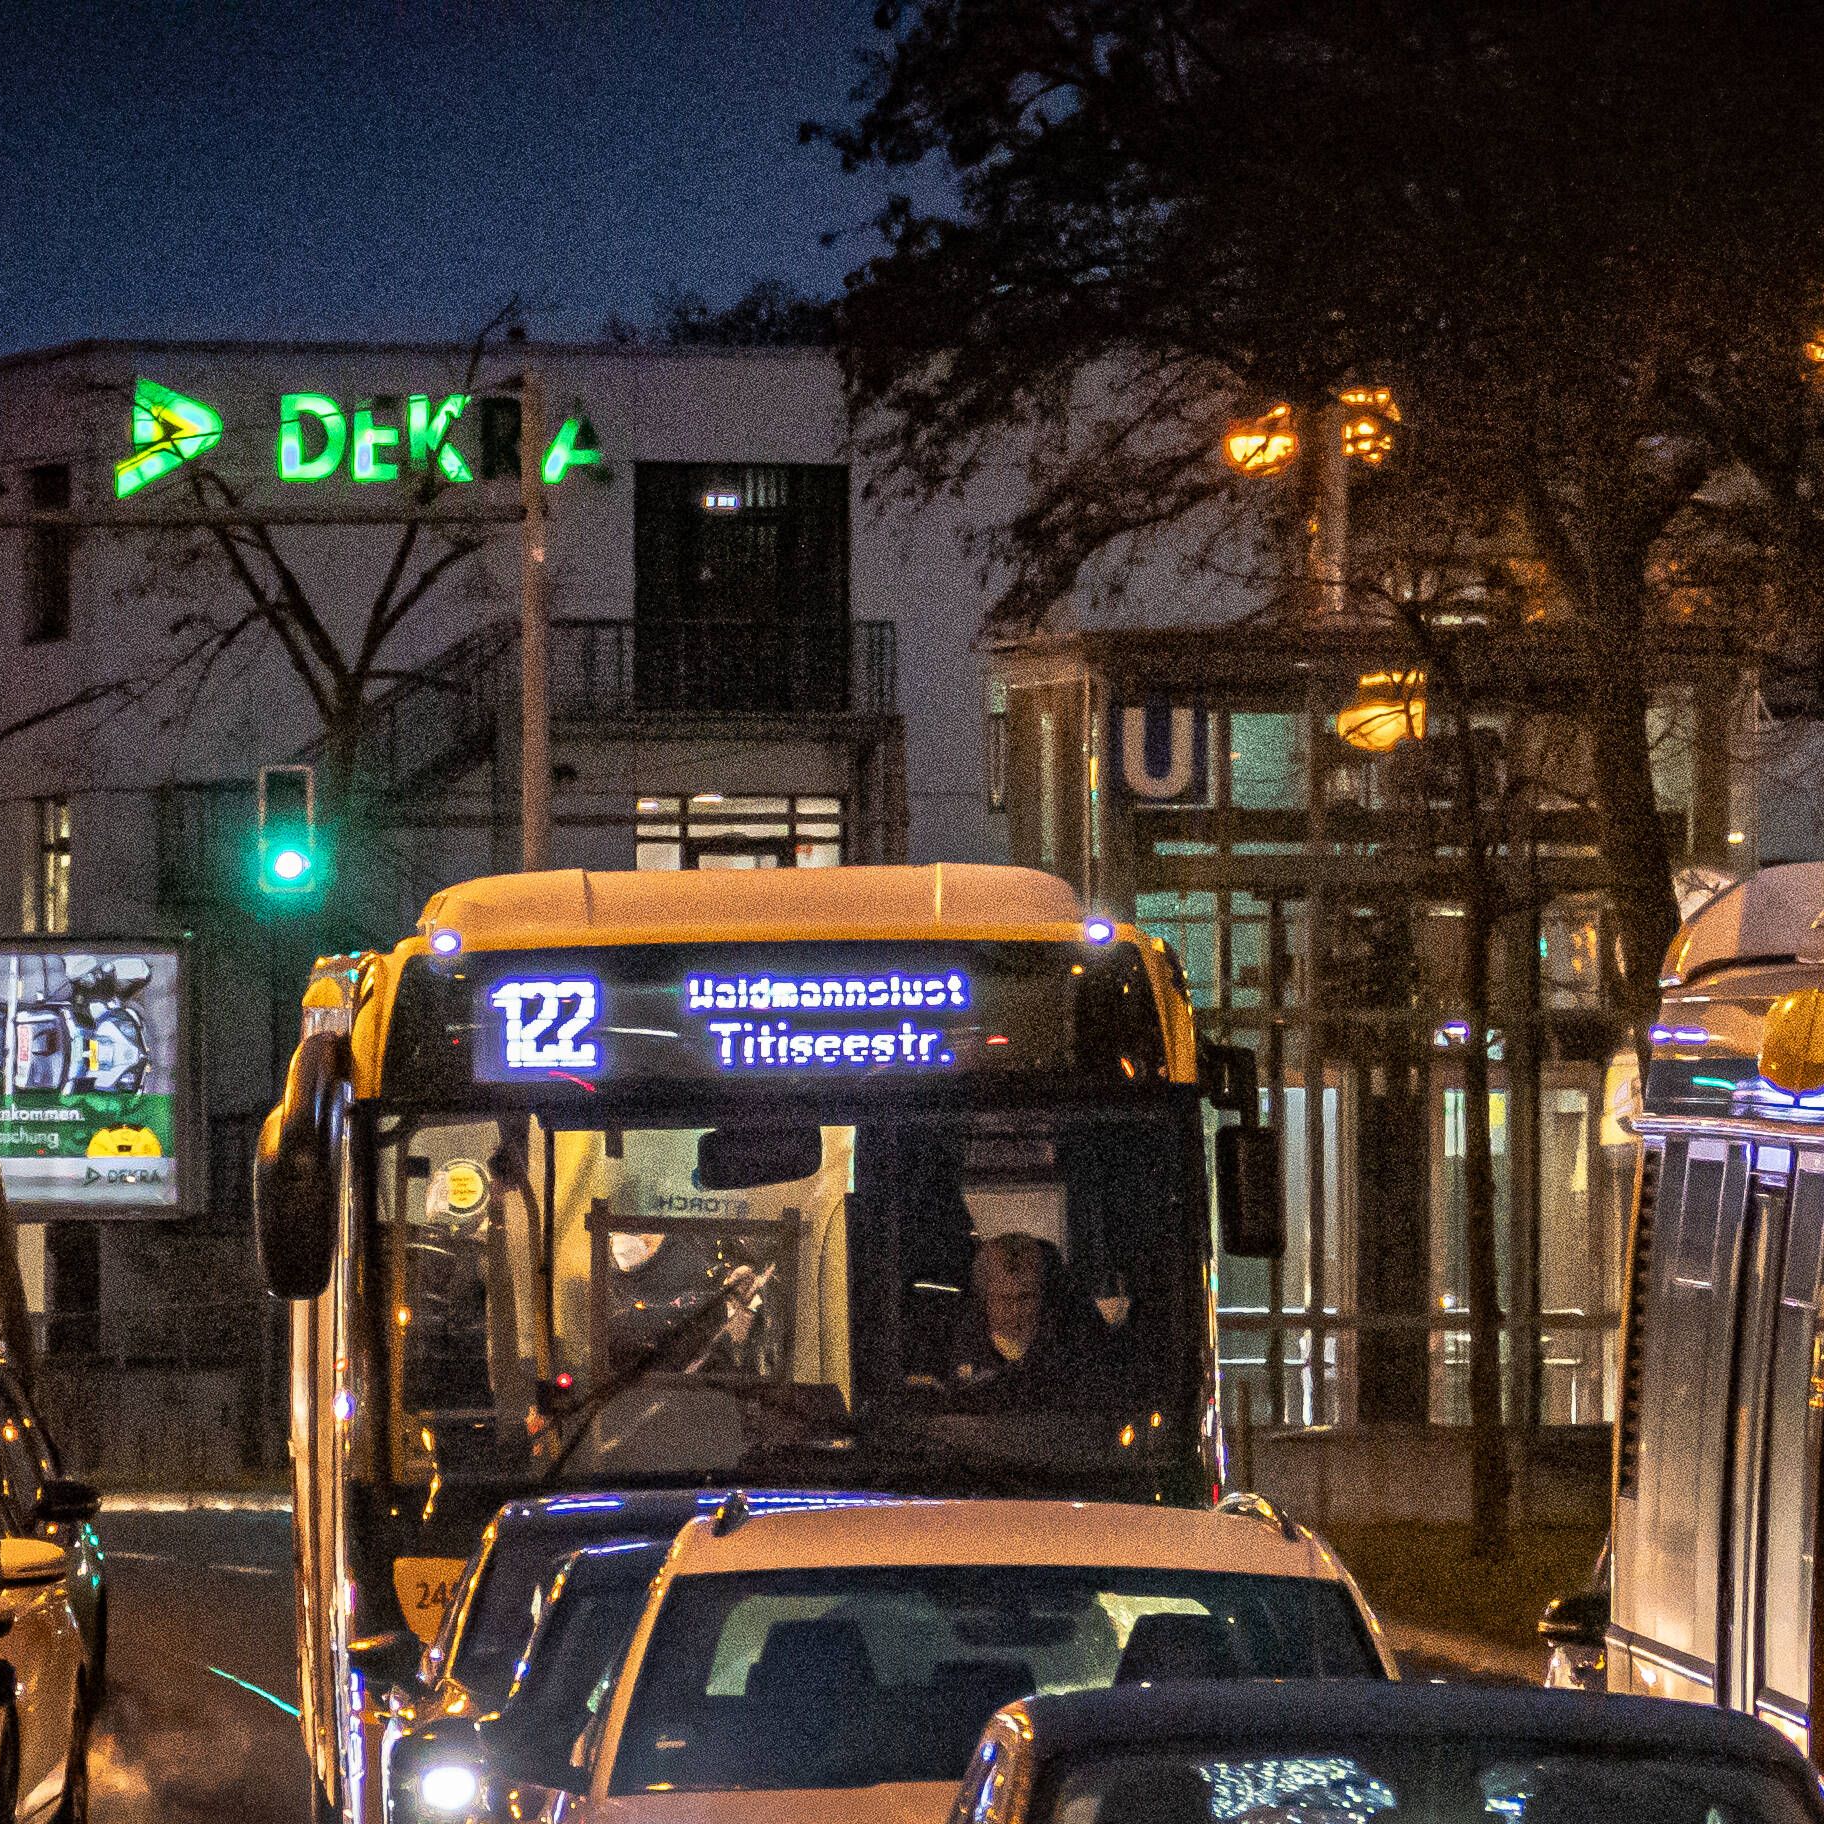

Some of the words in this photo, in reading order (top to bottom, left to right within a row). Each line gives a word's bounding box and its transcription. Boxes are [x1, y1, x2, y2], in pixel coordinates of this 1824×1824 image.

[1122, 705, 1195, 798] U
[492, 980, 597, 1068] 122
[710, 1021, 953, 1066] Titiseestr.
